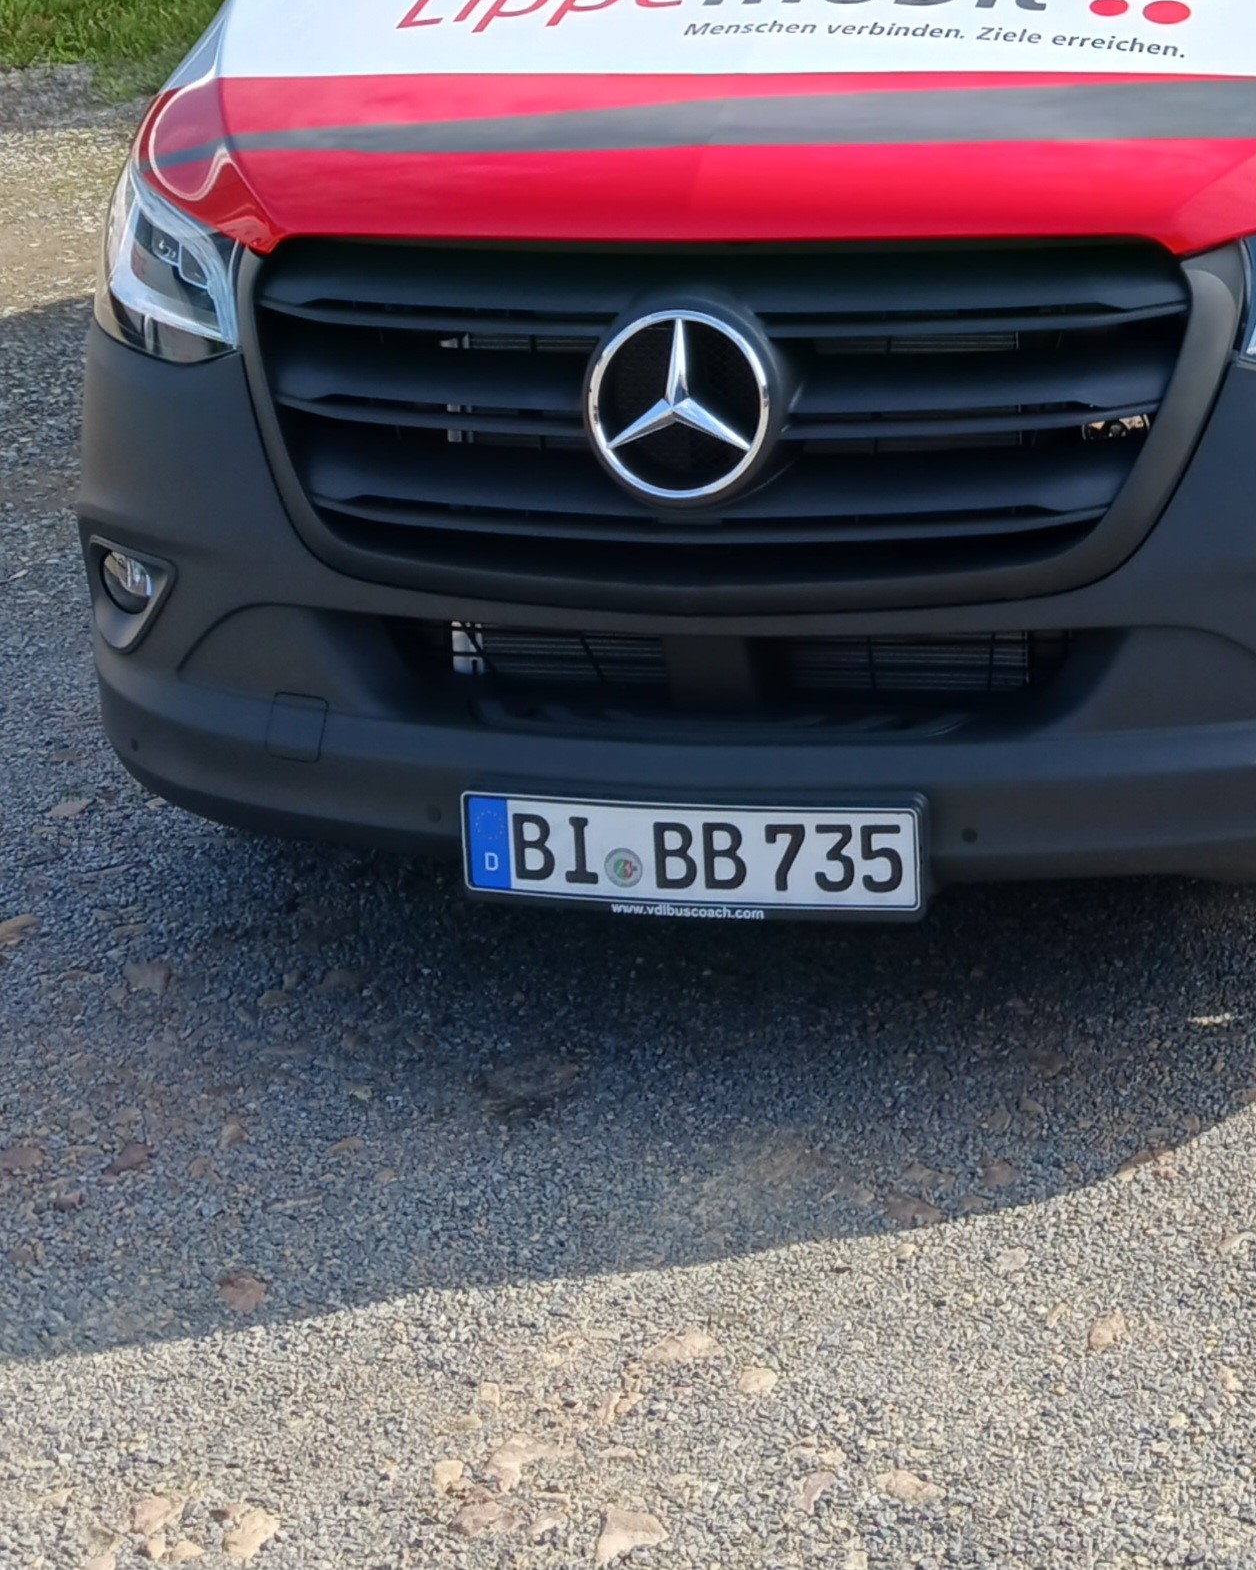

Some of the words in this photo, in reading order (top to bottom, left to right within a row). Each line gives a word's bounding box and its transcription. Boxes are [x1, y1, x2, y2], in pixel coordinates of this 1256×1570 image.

[683, 19, 818, 37] Menschen
[825, 21, 966, 41] verbinden.
[975, 25, 1043, 45] Ziele
[1051, 34, 1188, 59] erreichen.
[484, 851, 500, 871] D
[511, 812, 599, 886] BI
[764, 824, 903, 893] 735
